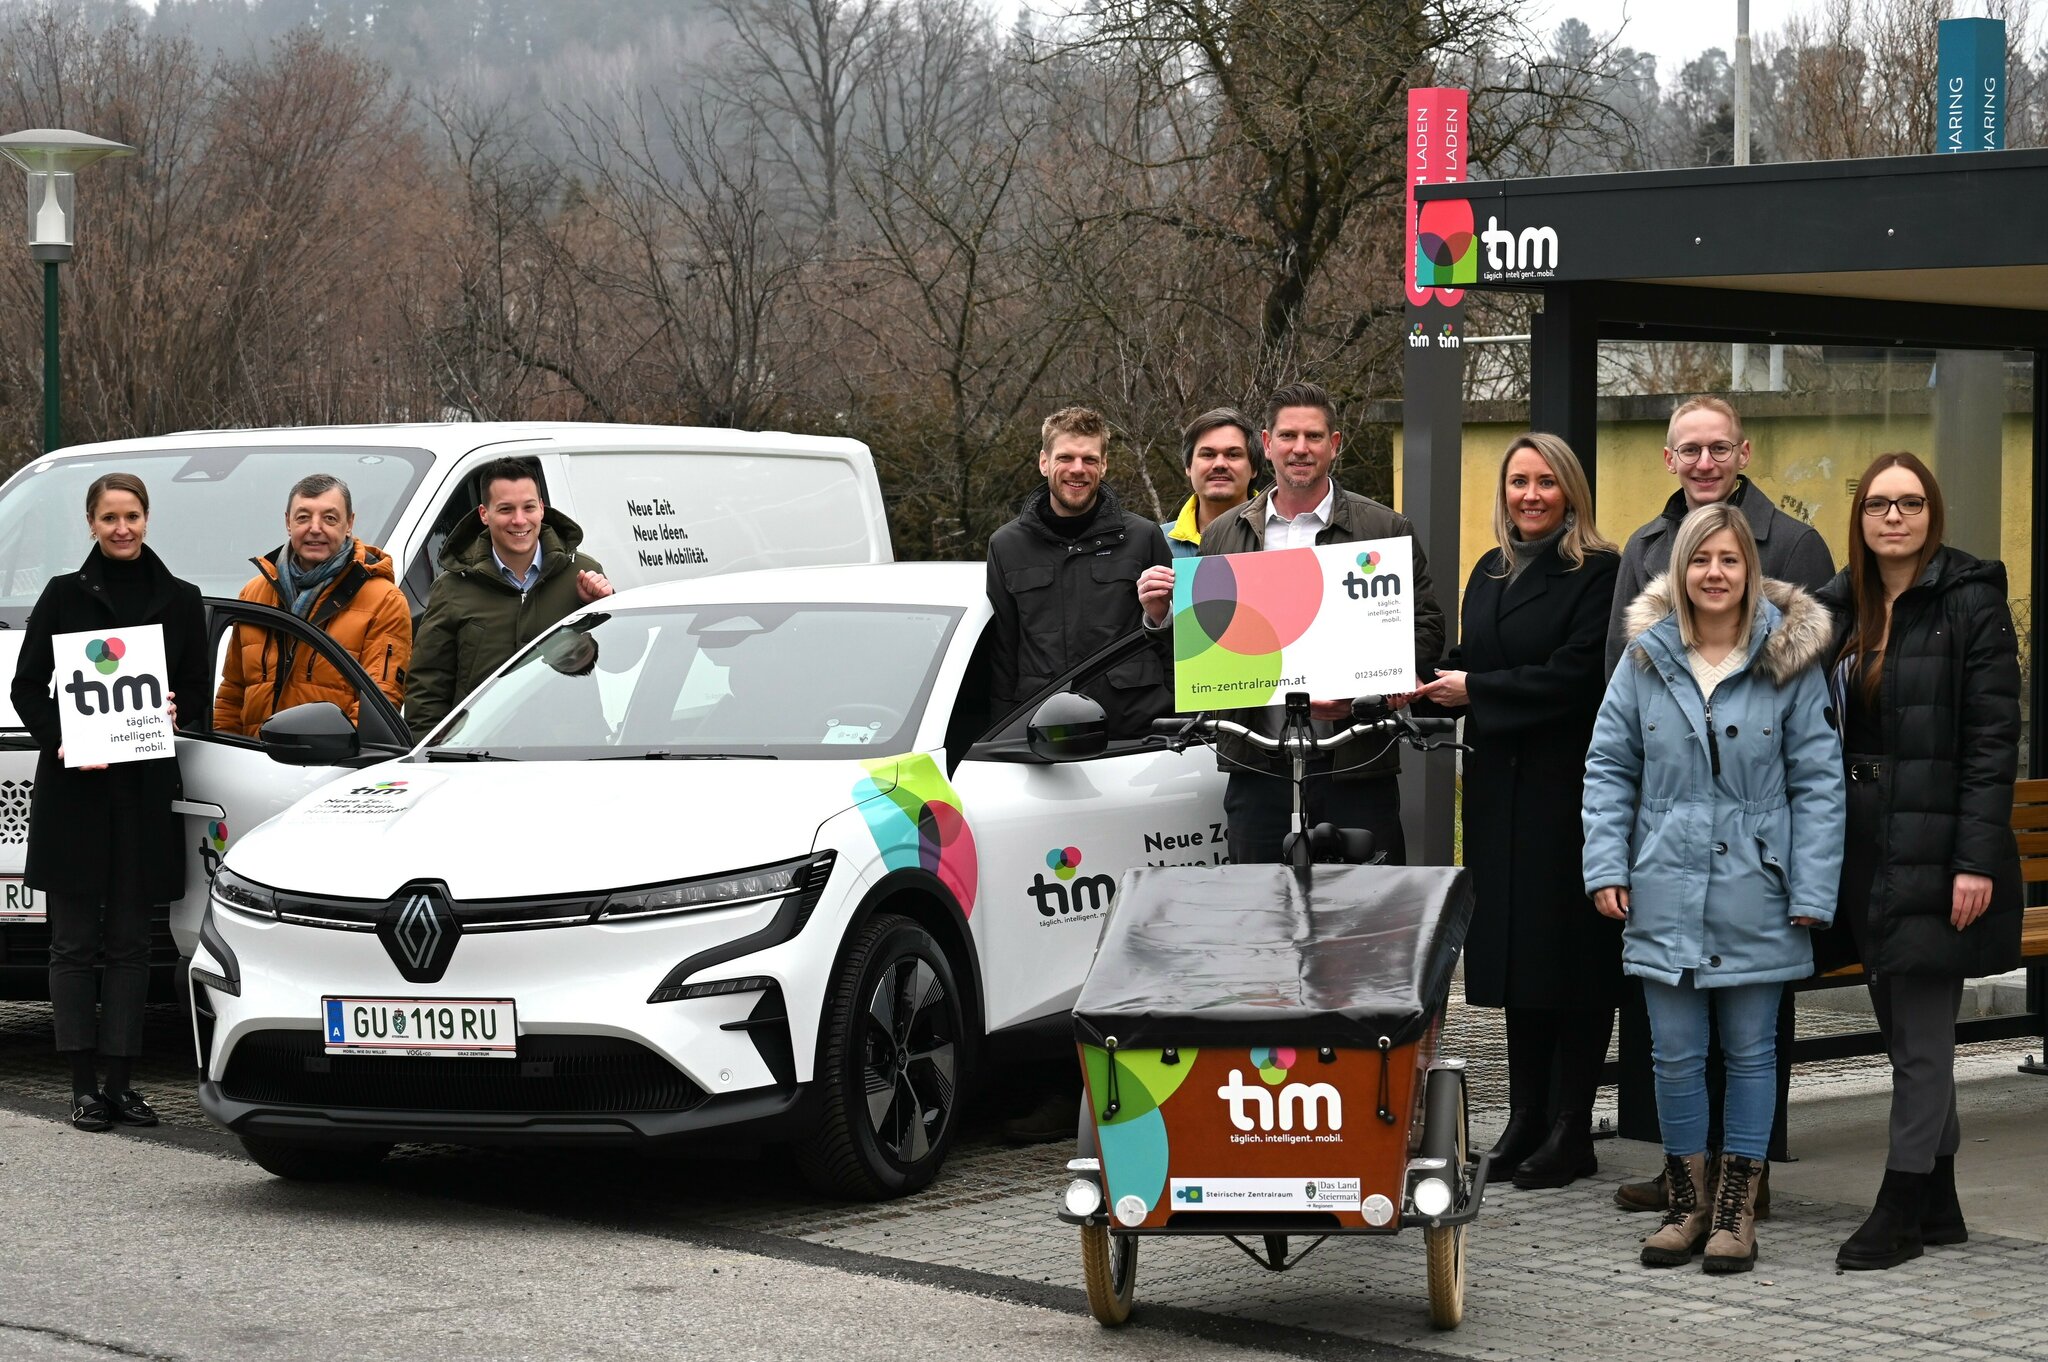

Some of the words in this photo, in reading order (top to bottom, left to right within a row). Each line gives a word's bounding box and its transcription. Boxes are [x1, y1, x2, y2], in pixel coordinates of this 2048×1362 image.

[1416, 108, 1428, 170] LADEN
[1445, 108, 1458, 170] LADEN
[1481, 216, 1558, 270] tim
[1408, 332, 1430, 348] tim
[1437, 333, 1460, 348] tim
[627, 500, 653, 516] Neue
[653, 499, 675, 516] Zeit.
[633, 525, 659, 541] Neue
[659, 523, 688, 540] Ideen.
[638, 550, 664, 567] Neue
[664, 548, 708, 565] Mobilität.
[1342, 571, 1401, 600] tim
[1377, 599, 1401, 607] täglich.
[1367, 609, 1401, 617] intelligent.
[1355, 668, 1403, 679] 0123456789
[1191, 675, 1306, 693] tim-zentralraum.at
[65, 670, 162, 716] tim
[126, 715, 164, 727] täglich.
[110, 730, 165, 742] intelligent.
[135, 742, 167, 753] mobil.
[1144, 832, 1204, 853] Neue
[199, 837, 228, 878] ti
[6, 884, 34, 910] RU
[1027, 873, 1116, 917] tim
[1040, 919, 1064, 928] täglich.
[1064, 913, 1099, 924] intelligent.
[332, 1027, 341, 1037] A
[354, 1006, 388, 1038] GU
[411, 1007, 454, 1040] 119
[461, 1008, 497, 1041] RU
[1217, 1069, 1343, 1131] tim
[1230, 1134, 1264, 1145] täglich.
[1265, 1134, 1314, 1145] intelligent.
[1315, 1134, 1343, 1143] mobil.
[1320, 1181, 1335, 1189] Das
[1337, 1181, 1358, 1189] Land
[1318, 1192, 1358, 1201] Steiermark
